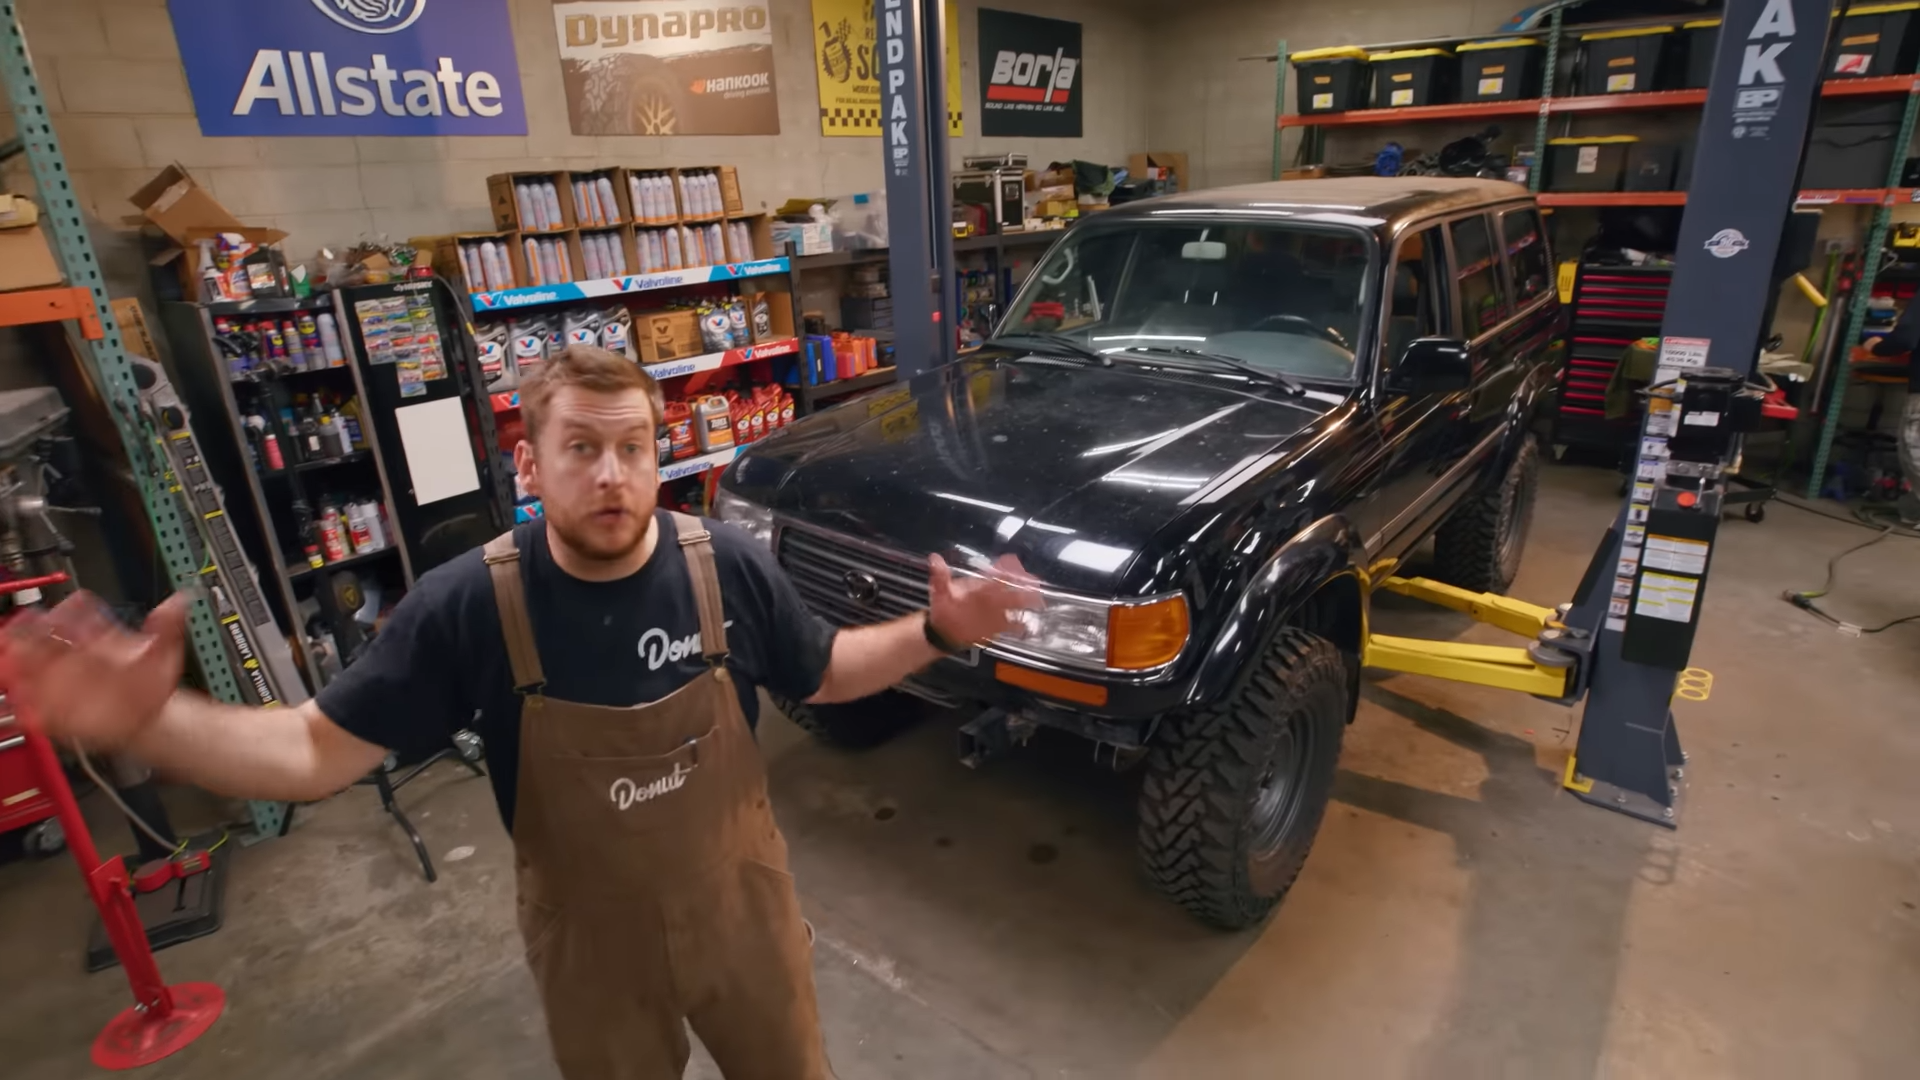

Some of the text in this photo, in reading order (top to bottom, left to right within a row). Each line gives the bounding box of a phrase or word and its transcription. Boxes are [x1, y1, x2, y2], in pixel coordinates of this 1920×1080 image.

[233, 49, 503, 117] Allstate
[503, 263, 782, 306] Valvoline Valvoline Valvoline
[650, 343, 791, 378] Valvoline Valvoline
[666, 462, 710, 479] Valvoline
[610, 762, 698, 810] Donut
